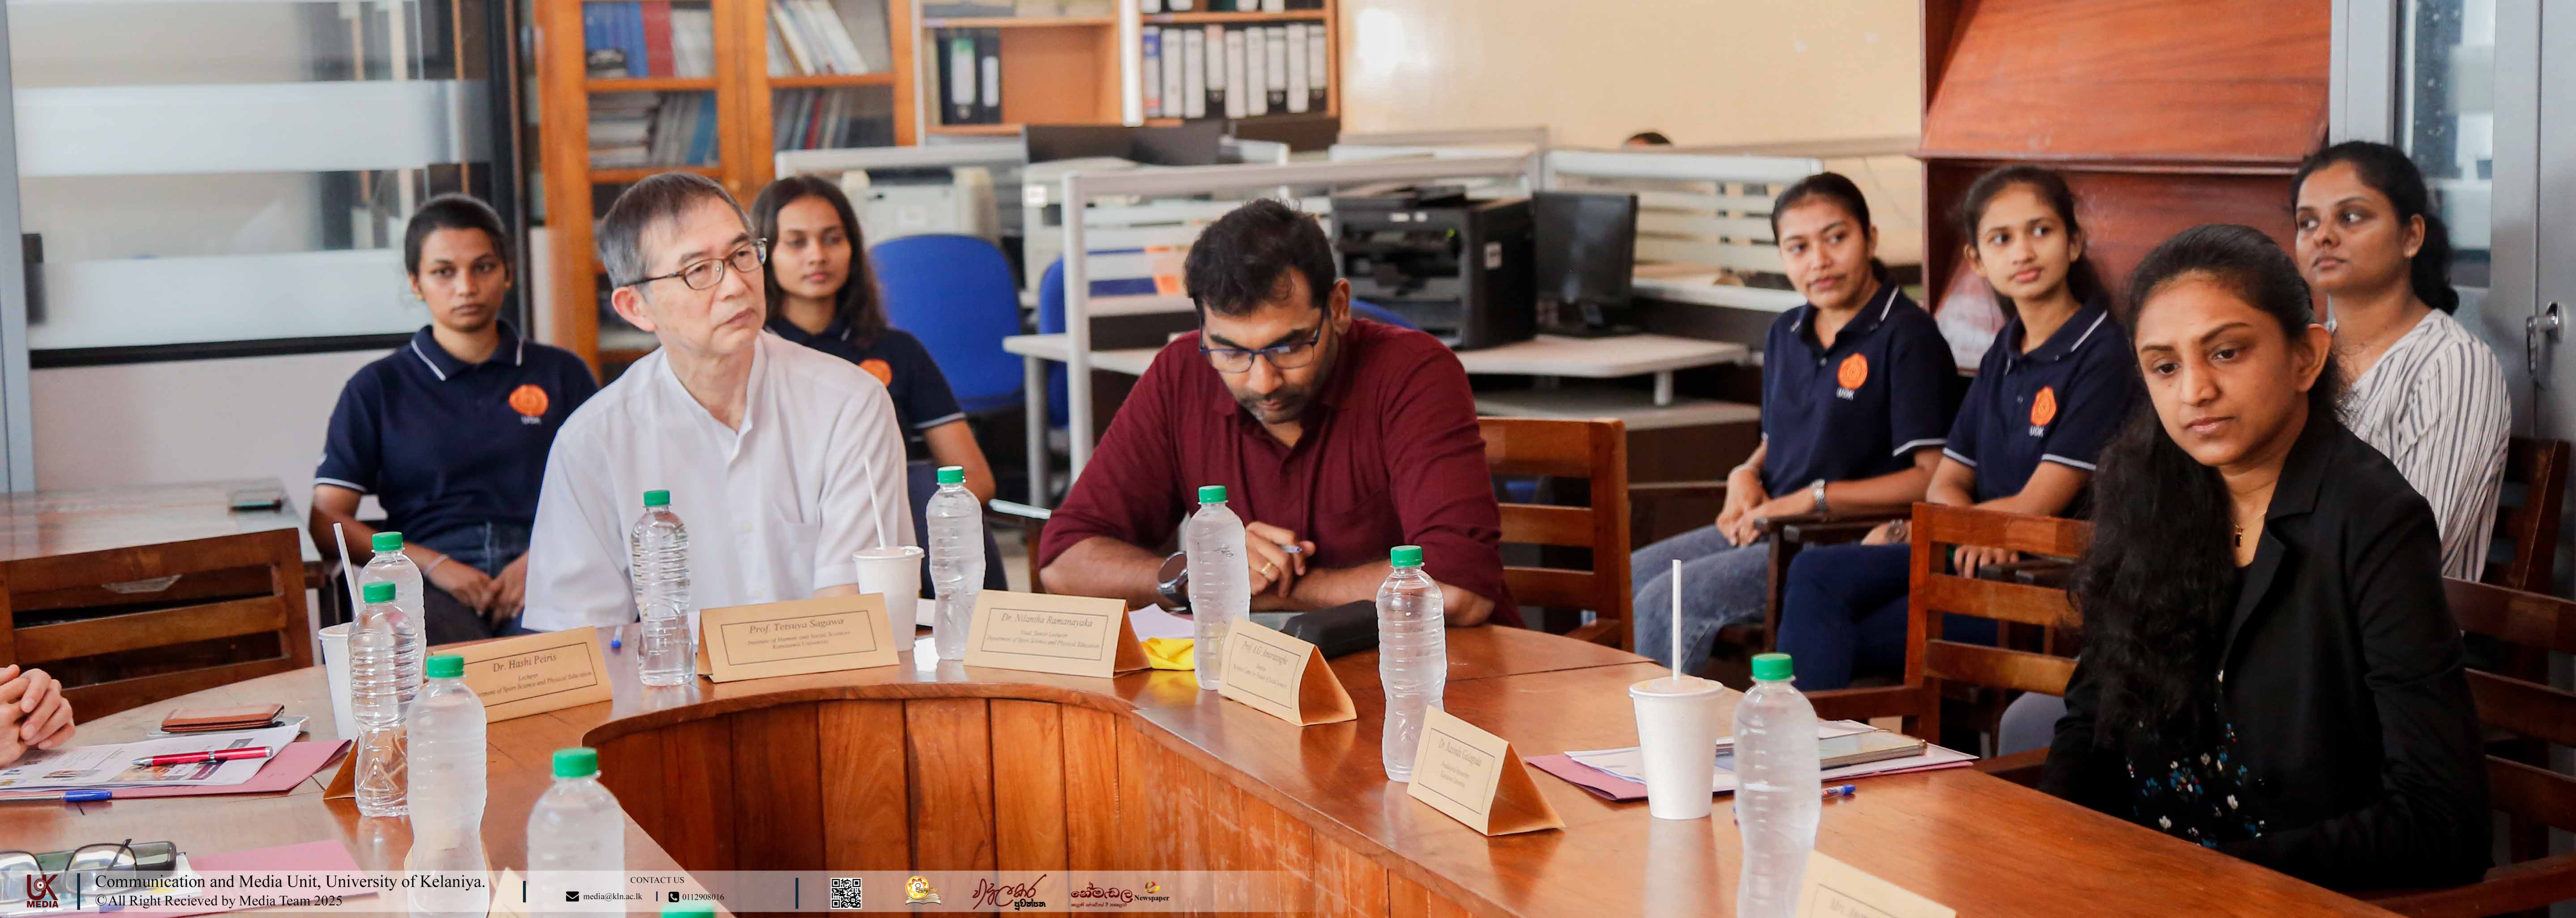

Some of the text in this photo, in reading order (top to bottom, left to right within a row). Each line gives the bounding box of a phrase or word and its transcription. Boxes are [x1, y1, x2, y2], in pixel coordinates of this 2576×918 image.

[749, 619, 845, 634] Prof. Tetsuya Sagawa
[493, 654, 557, 672] Dr. Hashi Peiris
